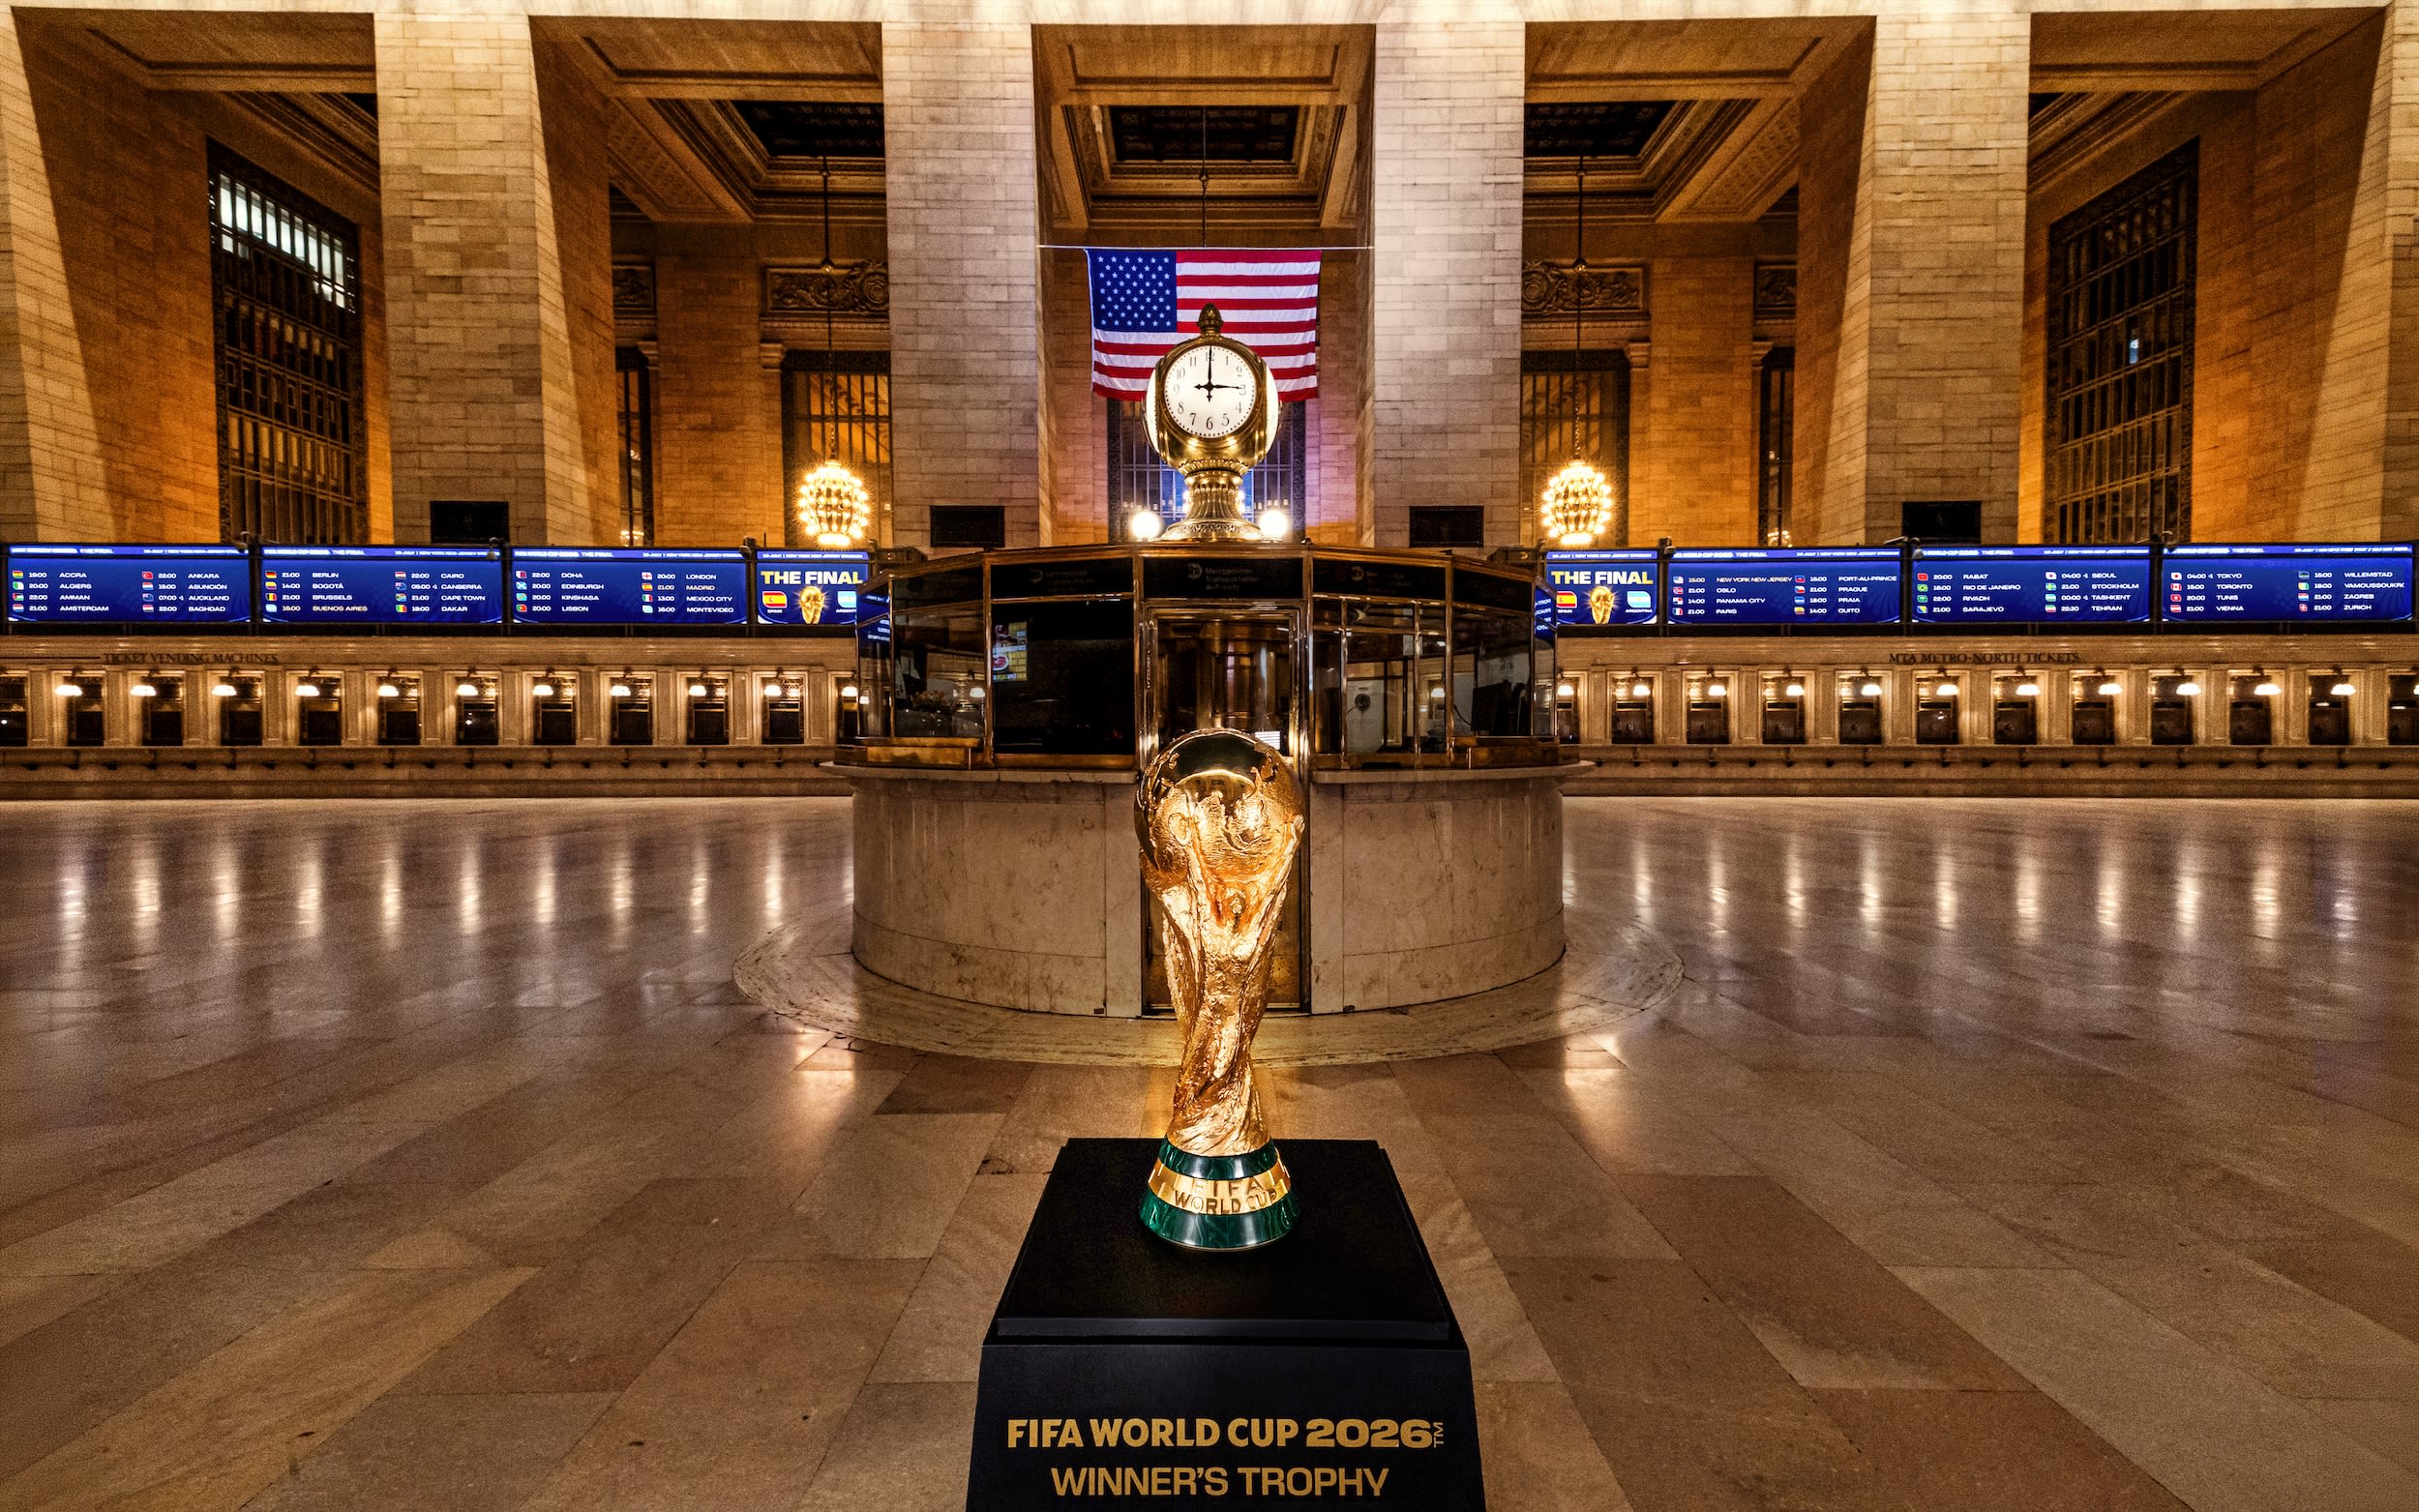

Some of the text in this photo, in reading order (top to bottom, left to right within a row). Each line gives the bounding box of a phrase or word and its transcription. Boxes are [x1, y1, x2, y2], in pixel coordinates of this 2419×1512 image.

[1189, 356, 1197, 367] 11
[1225, 355, 1229, 365] 1
[1176, 367, 1185, 378] 10
[1236, 367, 1242, 377] 2
[1173, 385, 1180, 395] 9
[1178, 402, 1184, 414] 8
[1236, 402, 1242, 414] 4
[1189, 412, 1197, 426] 7
[1206, 416, 1213, 430] 6
[1221, 413, 1230, 427] 5
[761, 571, 864, 584] THE FINAL
[1551, 571, 1654, 584] THE FINAL
[104, 653, 280, 666] TICKET VENDING MACHINES
[1889, 652, 2079, 665] MTA METRO-NORTH TICKETS
[1192, 1178, 1262, 1197] FIFA
[1174, 1189, 1277, 1214] WORLD CUP
[1007, 1419, 1085, 1448] FIFA
[1091, 1417, 1221, 1448] WORLD
[1227, 1417, 1298, 1448] CUP
[1050, 1467, 1389, 1497] WINNER'S TROPHY
